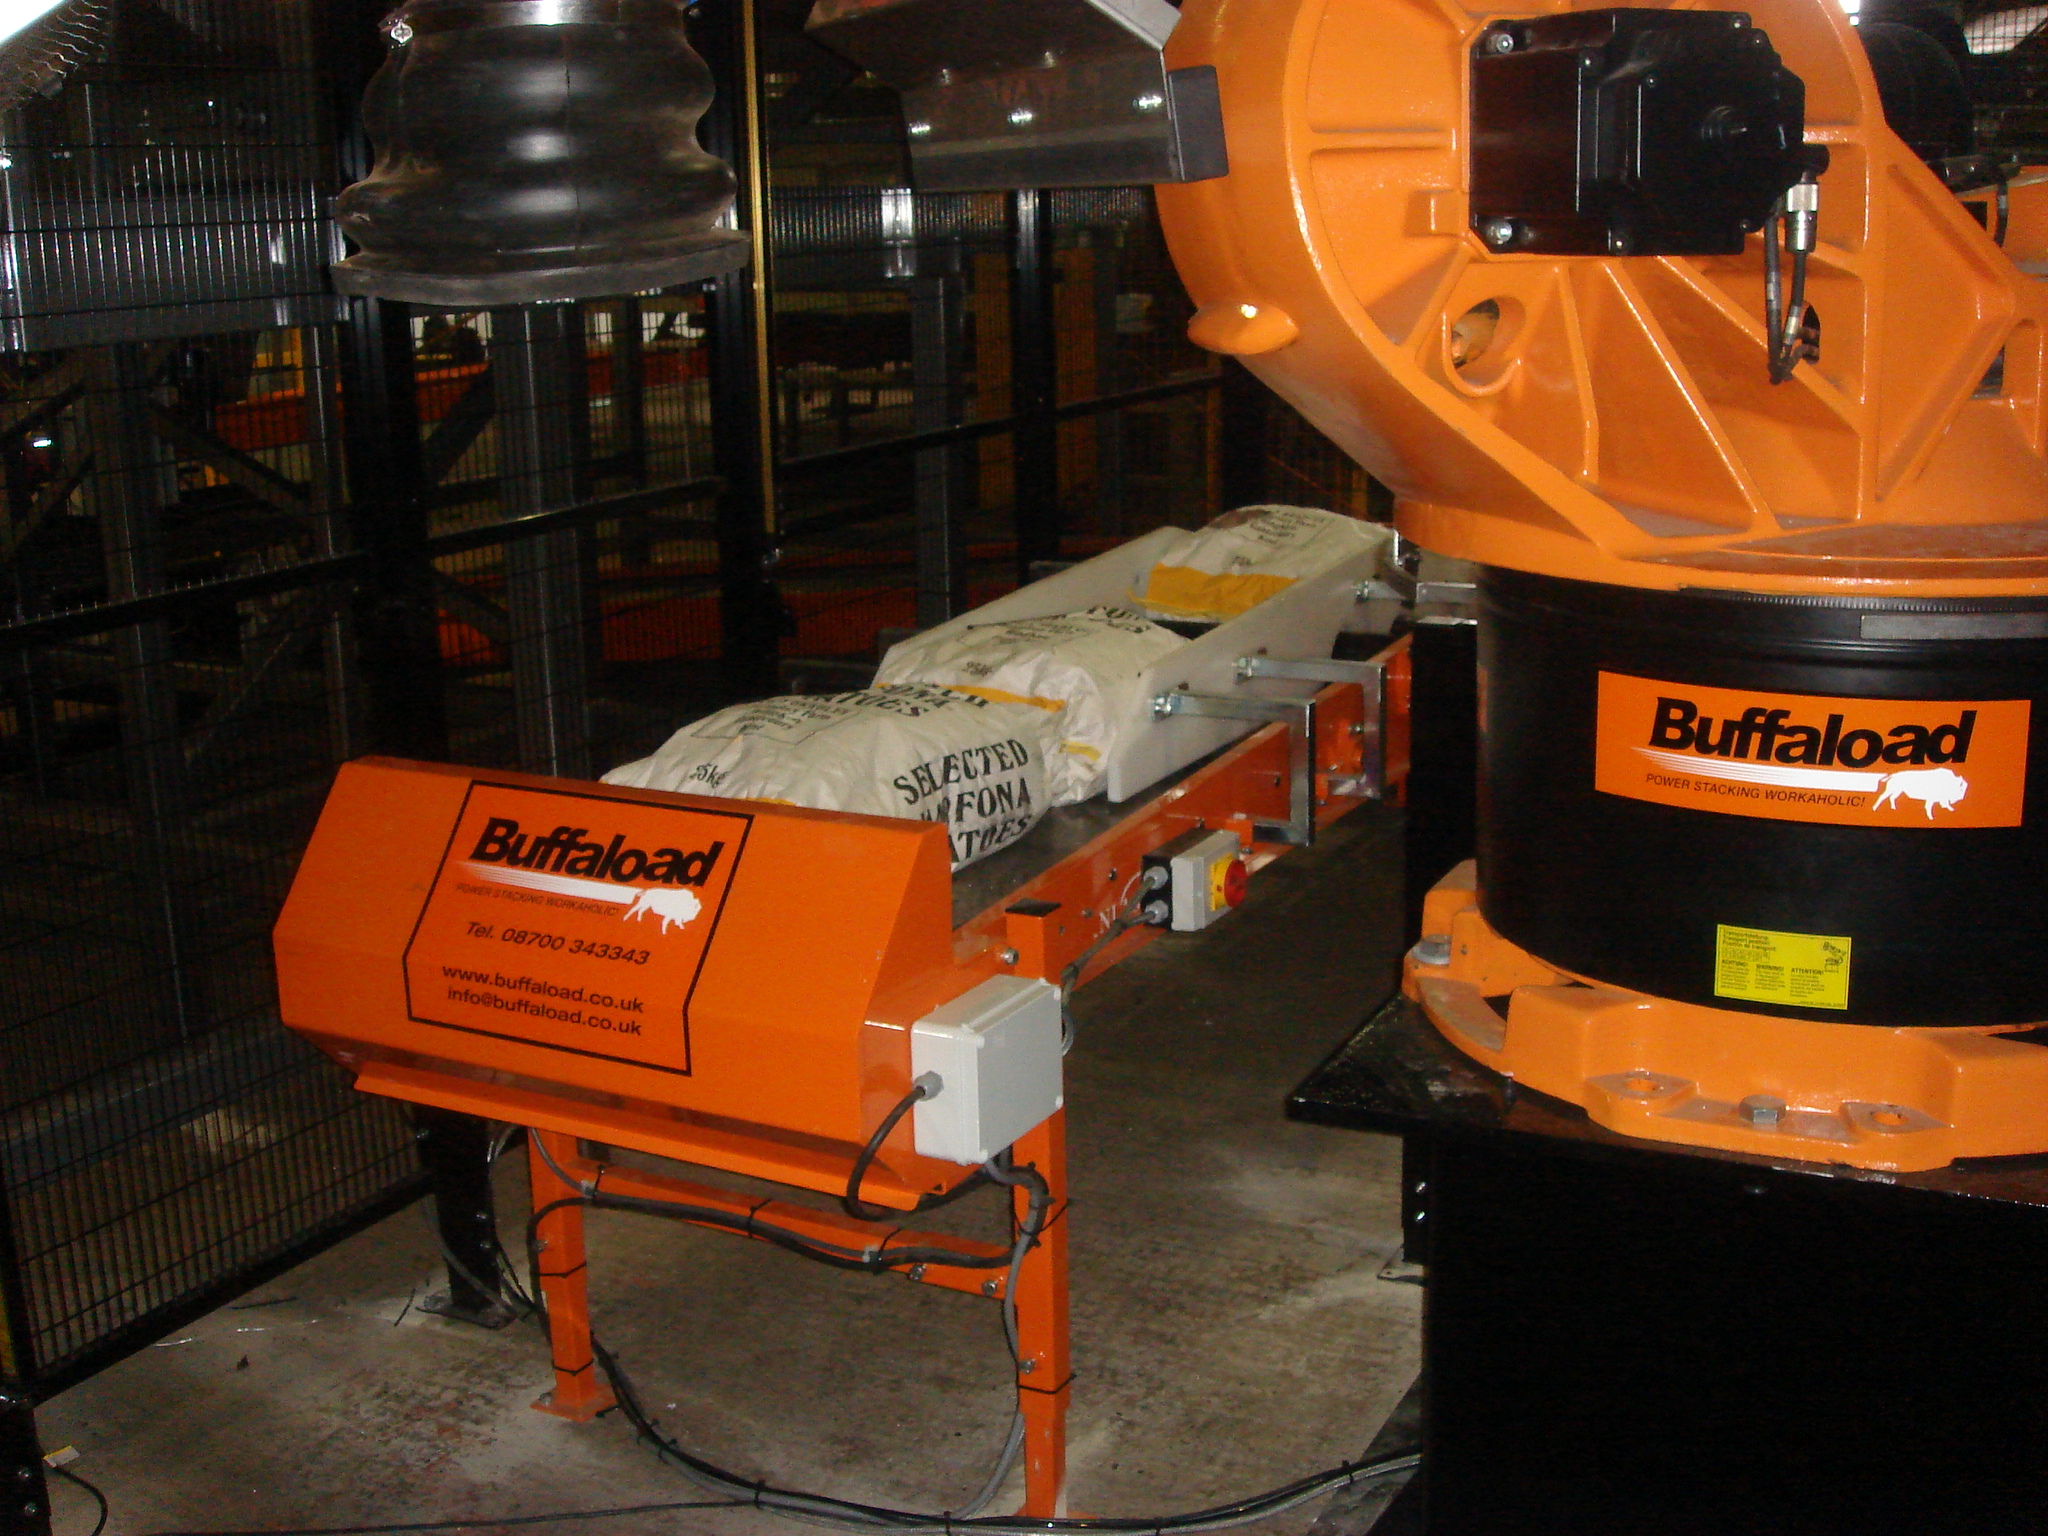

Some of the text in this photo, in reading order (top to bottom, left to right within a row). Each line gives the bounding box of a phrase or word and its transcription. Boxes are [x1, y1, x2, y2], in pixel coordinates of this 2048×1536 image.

[1649, 696, 1978, 769] Buffaload
[893, 739, 1029, 805] SELECTED
[1645, 773, 1866, 807] POWER STACKING WORKAHOLIC!
[469, 817, 726, 887] Buffaload
[455, 882, 493, 898] POWER
[493, 889, 544, 905] STACKING
[466, 921, 651, 966] Tel. 08700 343343
[442, 965, 645, 1013] www.buffaload.co.uk
[447, 986, 642, 1036] info@buffaload.co.uk
